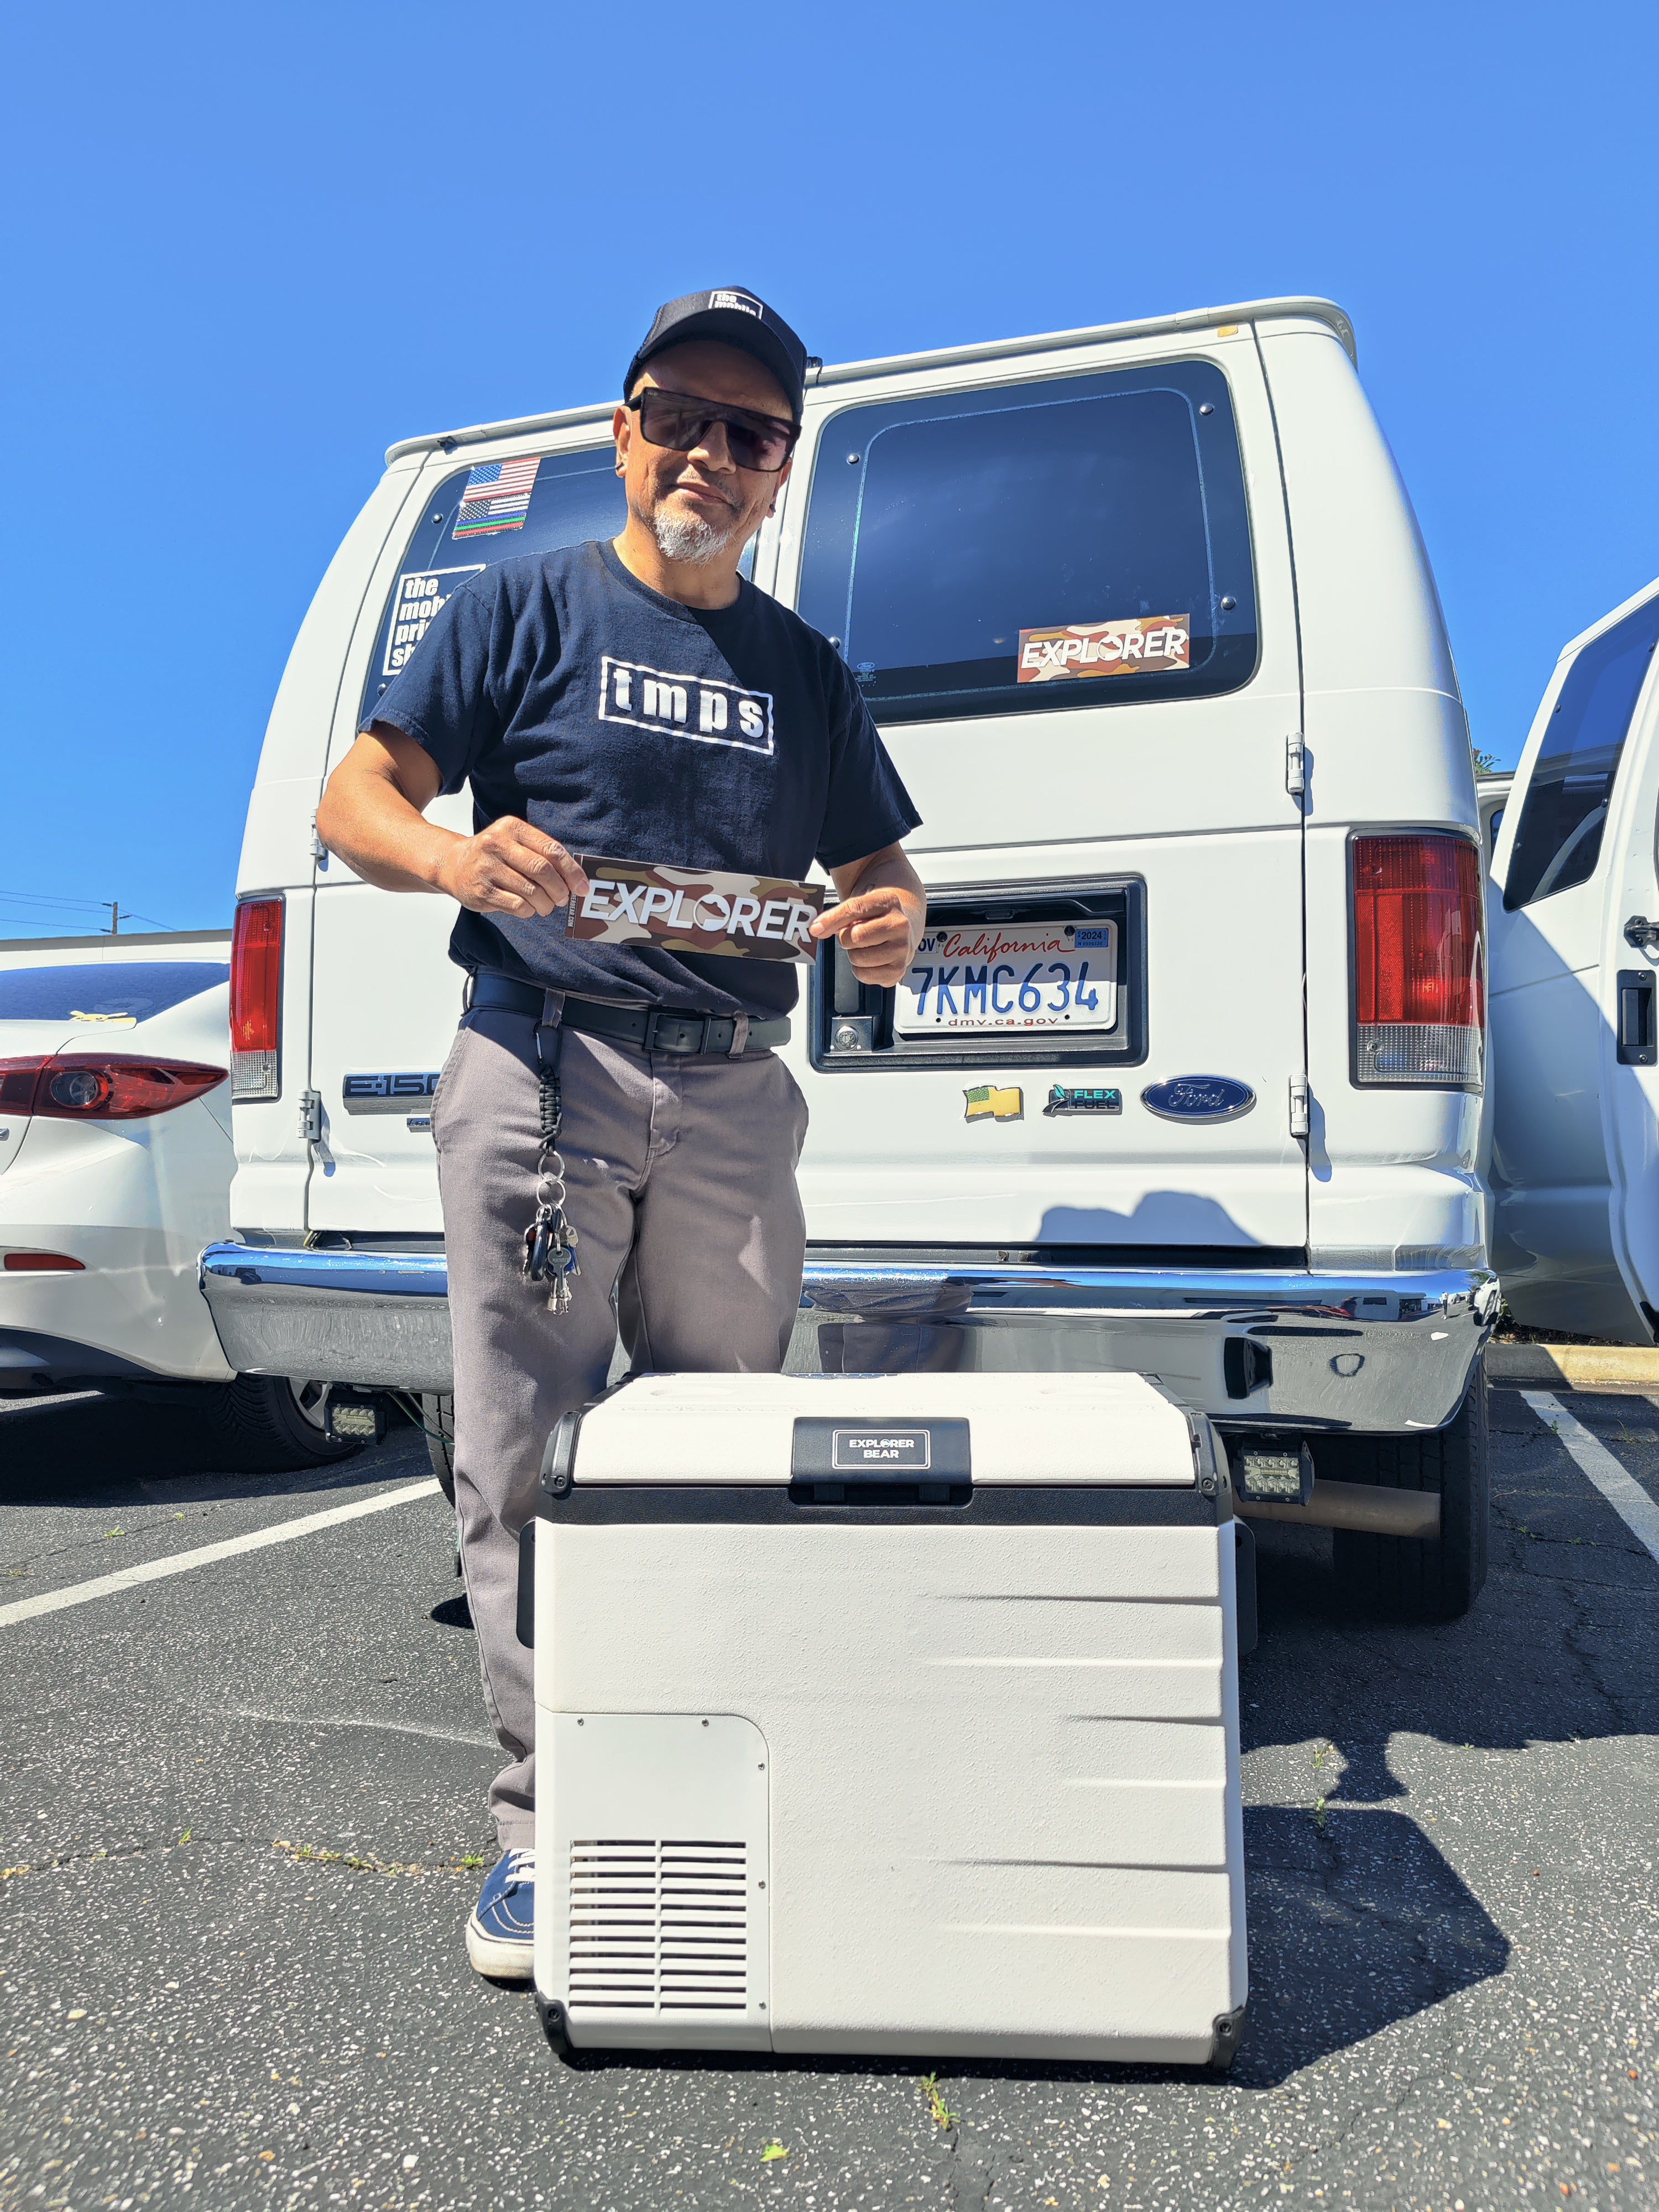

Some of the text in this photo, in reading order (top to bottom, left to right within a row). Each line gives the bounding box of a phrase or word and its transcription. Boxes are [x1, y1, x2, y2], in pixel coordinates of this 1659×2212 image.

[717, 294, 737, 303] the
[405, 577, 439, 599] the
[399, 594, 452, 621] mob
[1021, 628, 1187, 669] EXPLORER
[613, 668, 764, 738] tmps
[567, 893, 577, 927] RERBEAR.COM
[580, 879, 818, 943] EXPLORER
[918, 938, 936, 952] OV
[1081, 931, 1102, 940] 2024
[943, 932, 1076, 963] California
[911, 961, 1099, 1015] 7KMC634
[948, 1018, 1058, 1026] dmv.ca.gov
[1074, 1090, 1116, 1099] FLEX
[1074, 1100, 1115, 1109] FUEL
[1168, 1083, 1225, 1107] Ford
[849, 1439, 915, 1448] EXPLORER
[863, 1449, 899, 1459] BEAR
